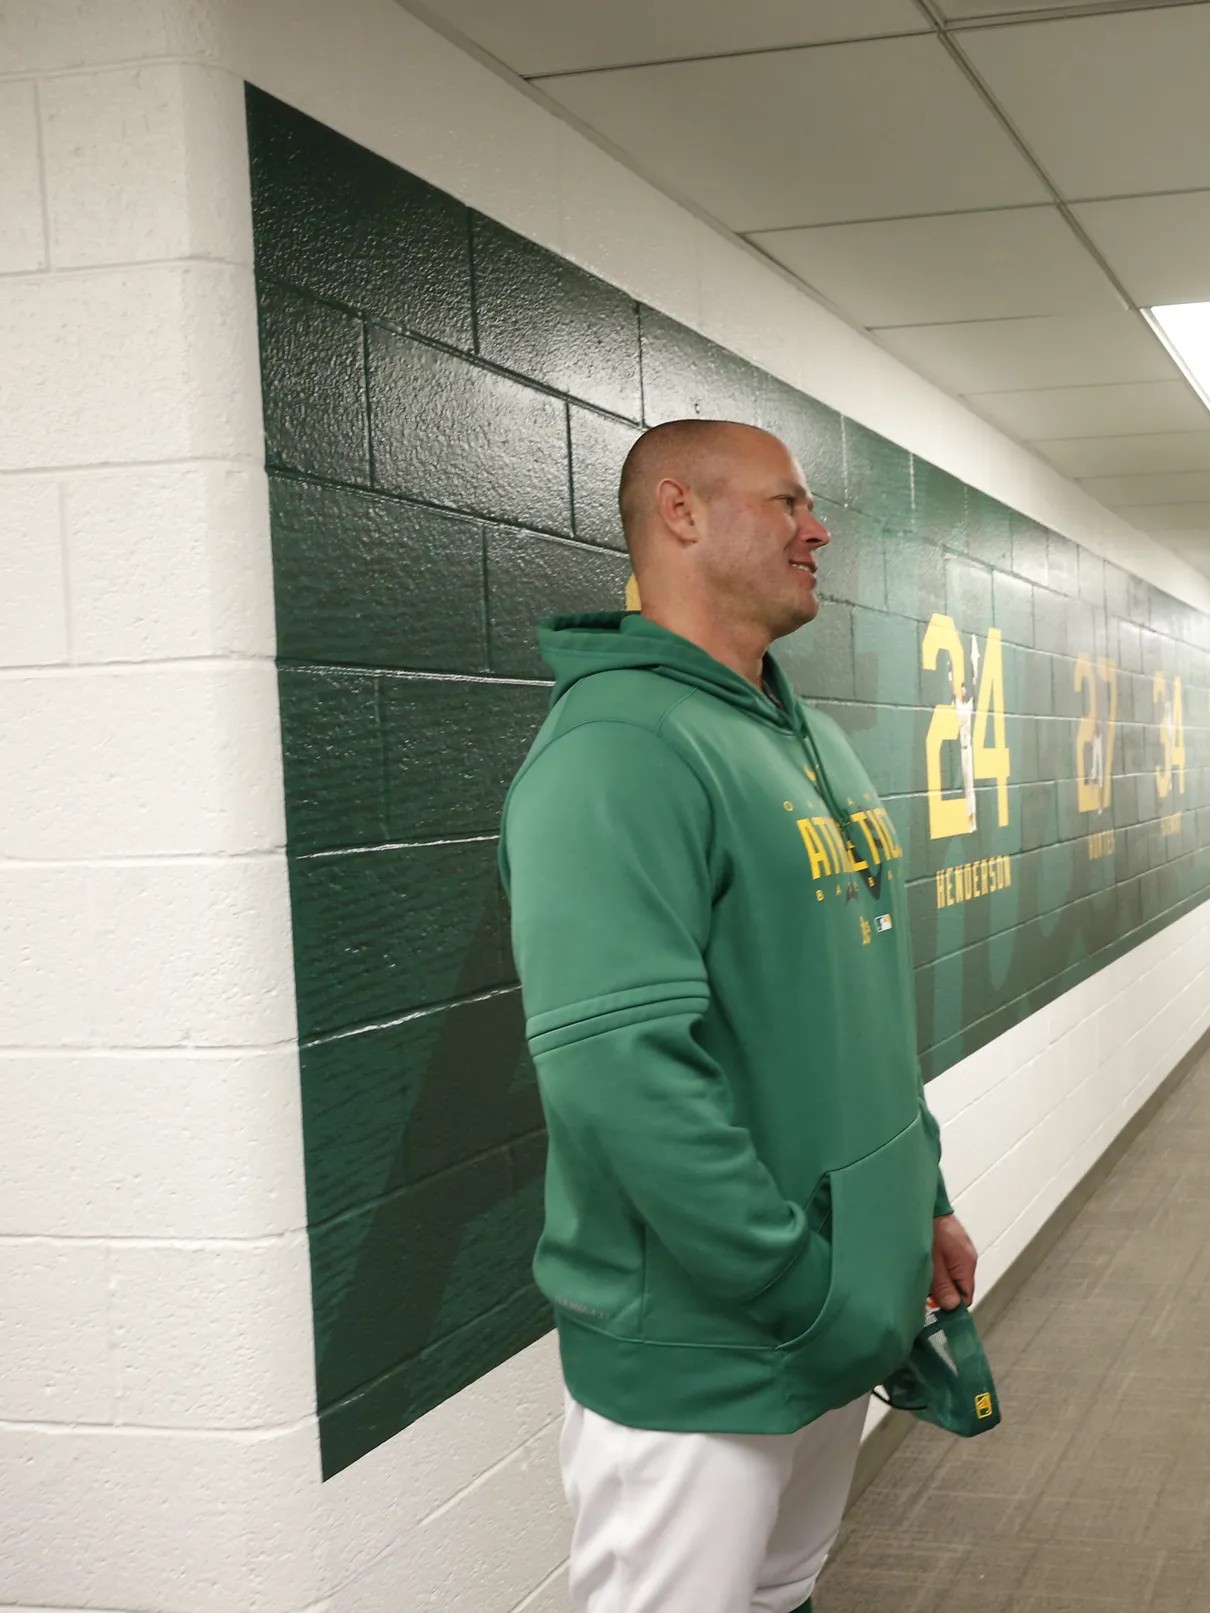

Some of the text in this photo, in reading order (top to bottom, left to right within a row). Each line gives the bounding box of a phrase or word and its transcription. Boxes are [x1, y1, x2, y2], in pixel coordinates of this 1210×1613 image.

[922, 613, 1011, 840] 24
[1073, 652, 1118, 813] 27
[936, 854, 1012, 910] HENDERSON
